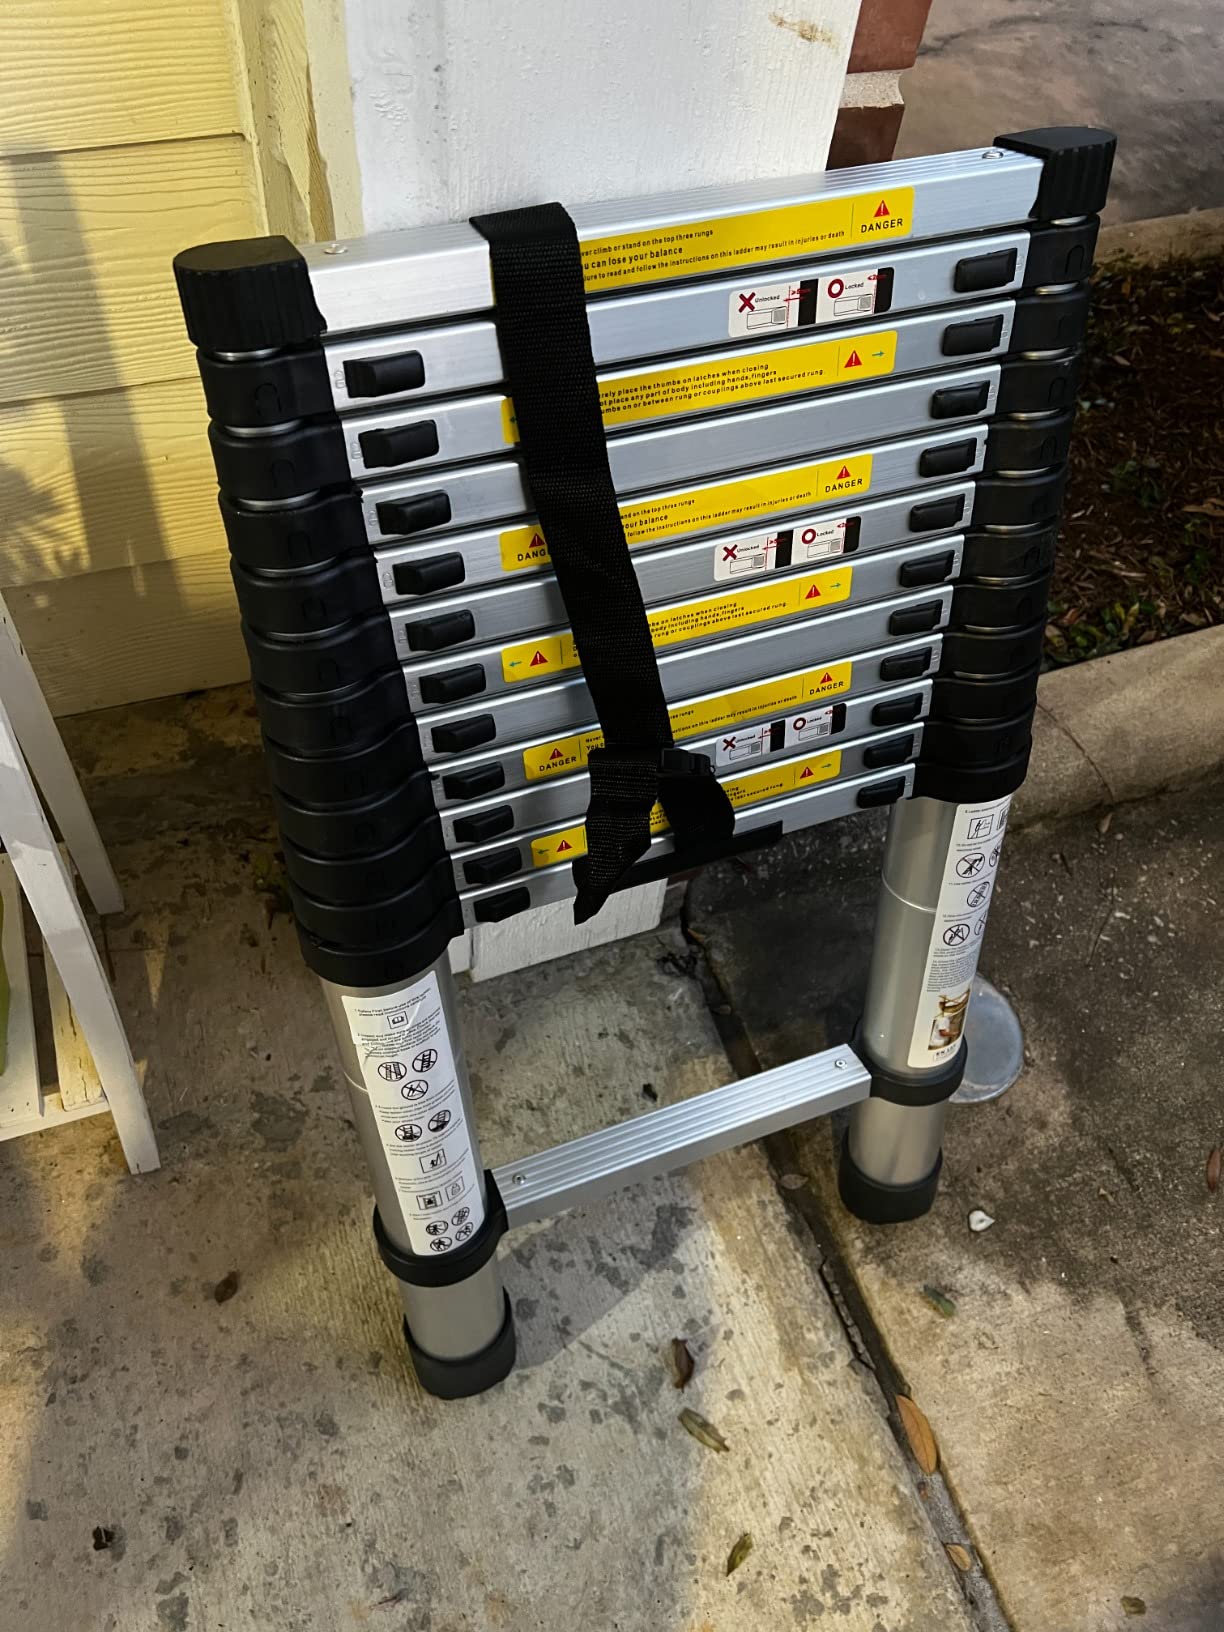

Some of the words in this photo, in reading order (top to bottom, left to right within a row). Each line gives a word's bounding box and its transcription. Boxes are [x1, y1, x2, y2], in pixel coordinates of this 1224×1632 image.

[860, 218, 904, 234] DANGER
[591, 260, 606, 268] can
[608, 257, 626, 266] lose
[628, 253, 648, 264] your
[650, 247, 683, 258] balance
[844, 282, 865, 290] Locked
[754, 294, 781, 304] Unlocked
[601, 390, 616, 398] rely
[825, 478, 863, 493] DANGER
[816, 529, 834, 538] Locked
[517, 549, 546, 562] DANG
[809, 681, 844, 696] DANGER
[539, 756, 577, 772] DANGER
